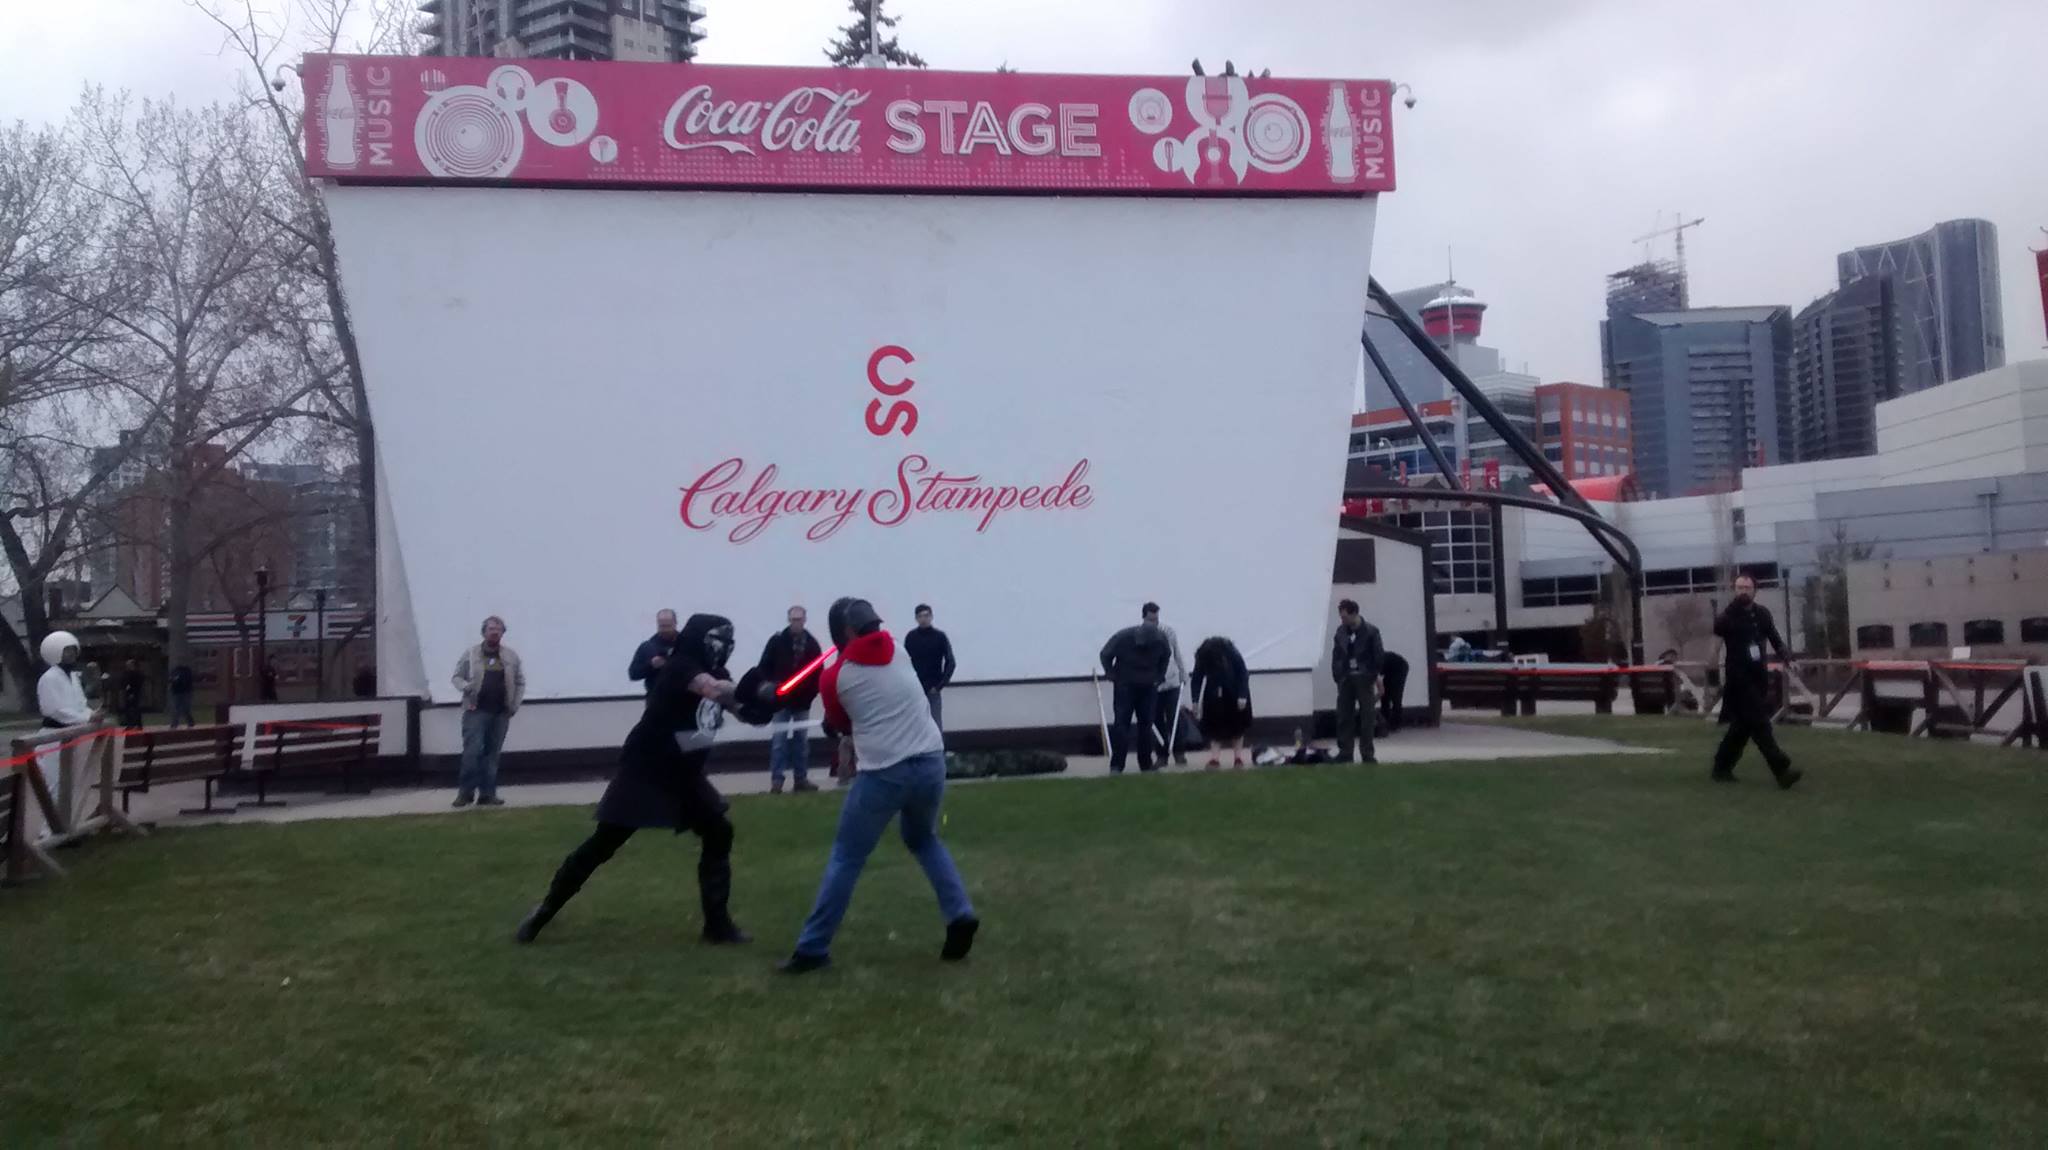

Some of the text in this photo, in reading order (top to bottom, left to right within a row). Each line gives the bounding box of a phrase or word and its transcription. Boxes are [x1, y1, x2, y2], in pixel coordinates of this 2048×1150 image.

[367, 66, 393, 166] MUSIC
[663, 85, 1101, 157] Coca-Cola STAGE
[1361, 88, 1385, 179] MUSIC
[680, 454, 1095, 544] Calgary Stampede
